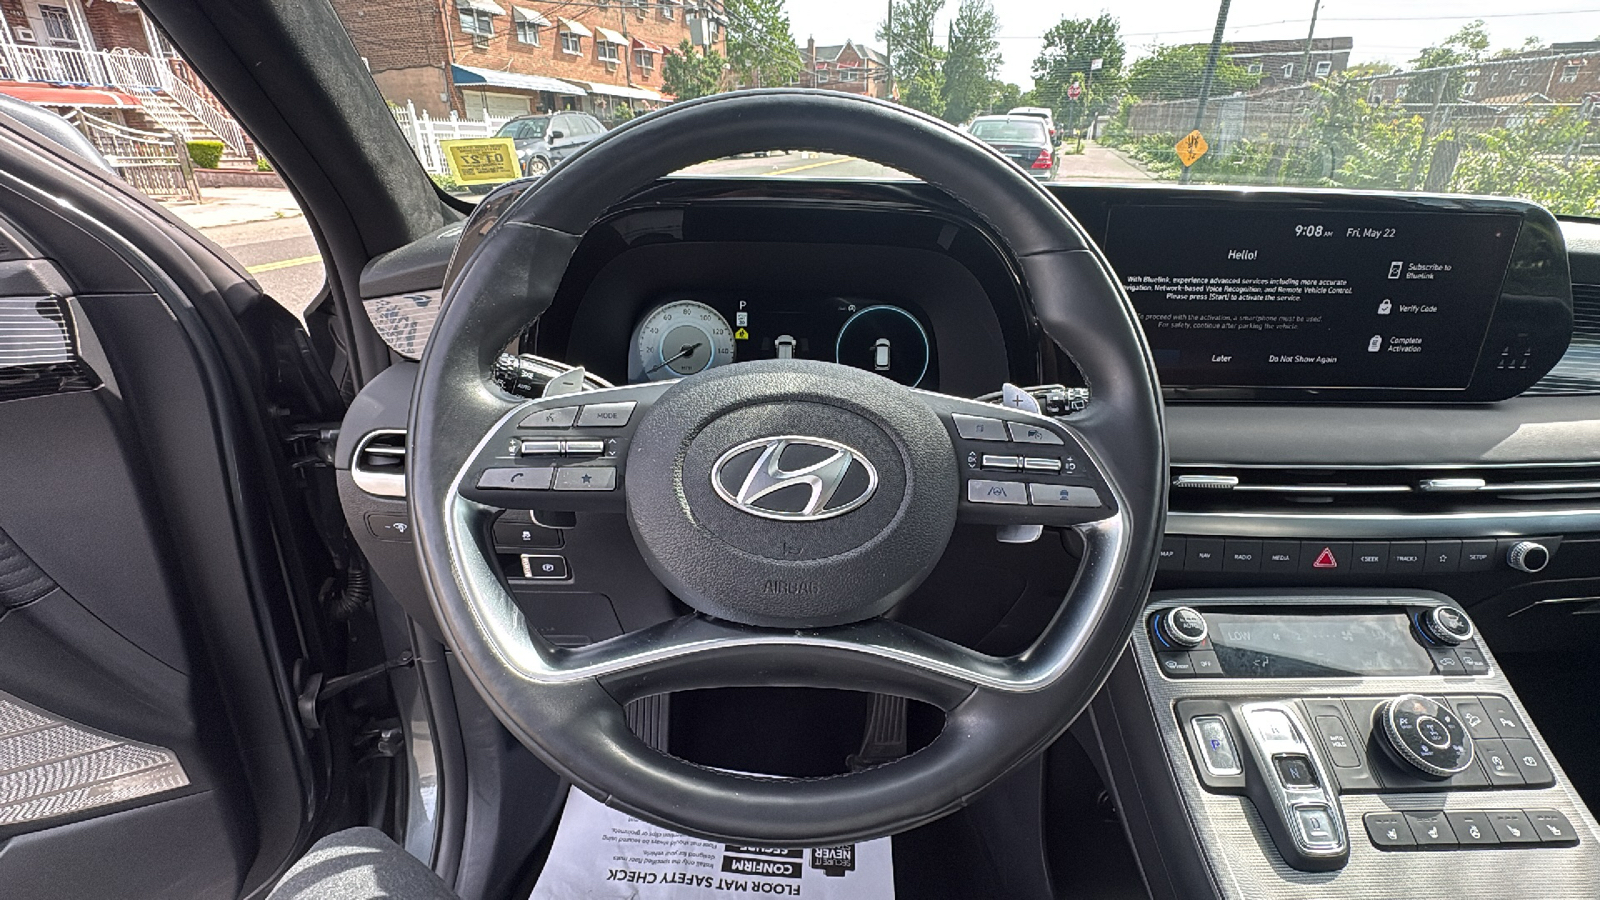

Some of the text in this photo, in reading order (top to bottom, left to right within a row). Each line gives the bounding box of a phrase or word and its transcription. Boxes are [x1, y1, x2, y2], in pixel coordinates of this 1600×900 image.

[1294, 225, 1323, 237] 9:08
[1363, 228, 1382, 240] May
[1383, 228, 1396, 238] 22
[1228, 249, 1258, 261] Hello!
[1407, 263, 1443, 271] Subscribe
[1172, 277, 1208, 285] experience
[1209, 277, 1240, 285] advanced
[1269, 278, 1299, 286] including
[1277, 286, 1302, 294] Remote
[1304, 286, 1328, 294] Vehicle
[739, 300, 747, 310] P
[1399, 304, 1438, 314] Verify Code
[682, 308, 692, 316] 80
[1188, 313, 1199, 321] the
[1389, 336, 1422, 345] Complete
[1387, 345, 1422, 353] Activation
[1211, 354, 1232, 363] Later
[1268, 354, 1337, 365] Do Not Show Again
[517, 383, 532, 391] AUTO
[597, 412, 618, 420] MODE
[763, 581, 819, 595] AIRBAG
[1227, 631, 1251, 641] LOW
[814, 848, 851, 860] NEVER
[682, 859, 695, 867] only
[695, 861, 714, 869] Install
[814, 858, 822, 866] IT
[731, 859, 793, 875] CONFIRM
[607, 868, 801, 896] FLOOR MAT SAFETY CHECK
